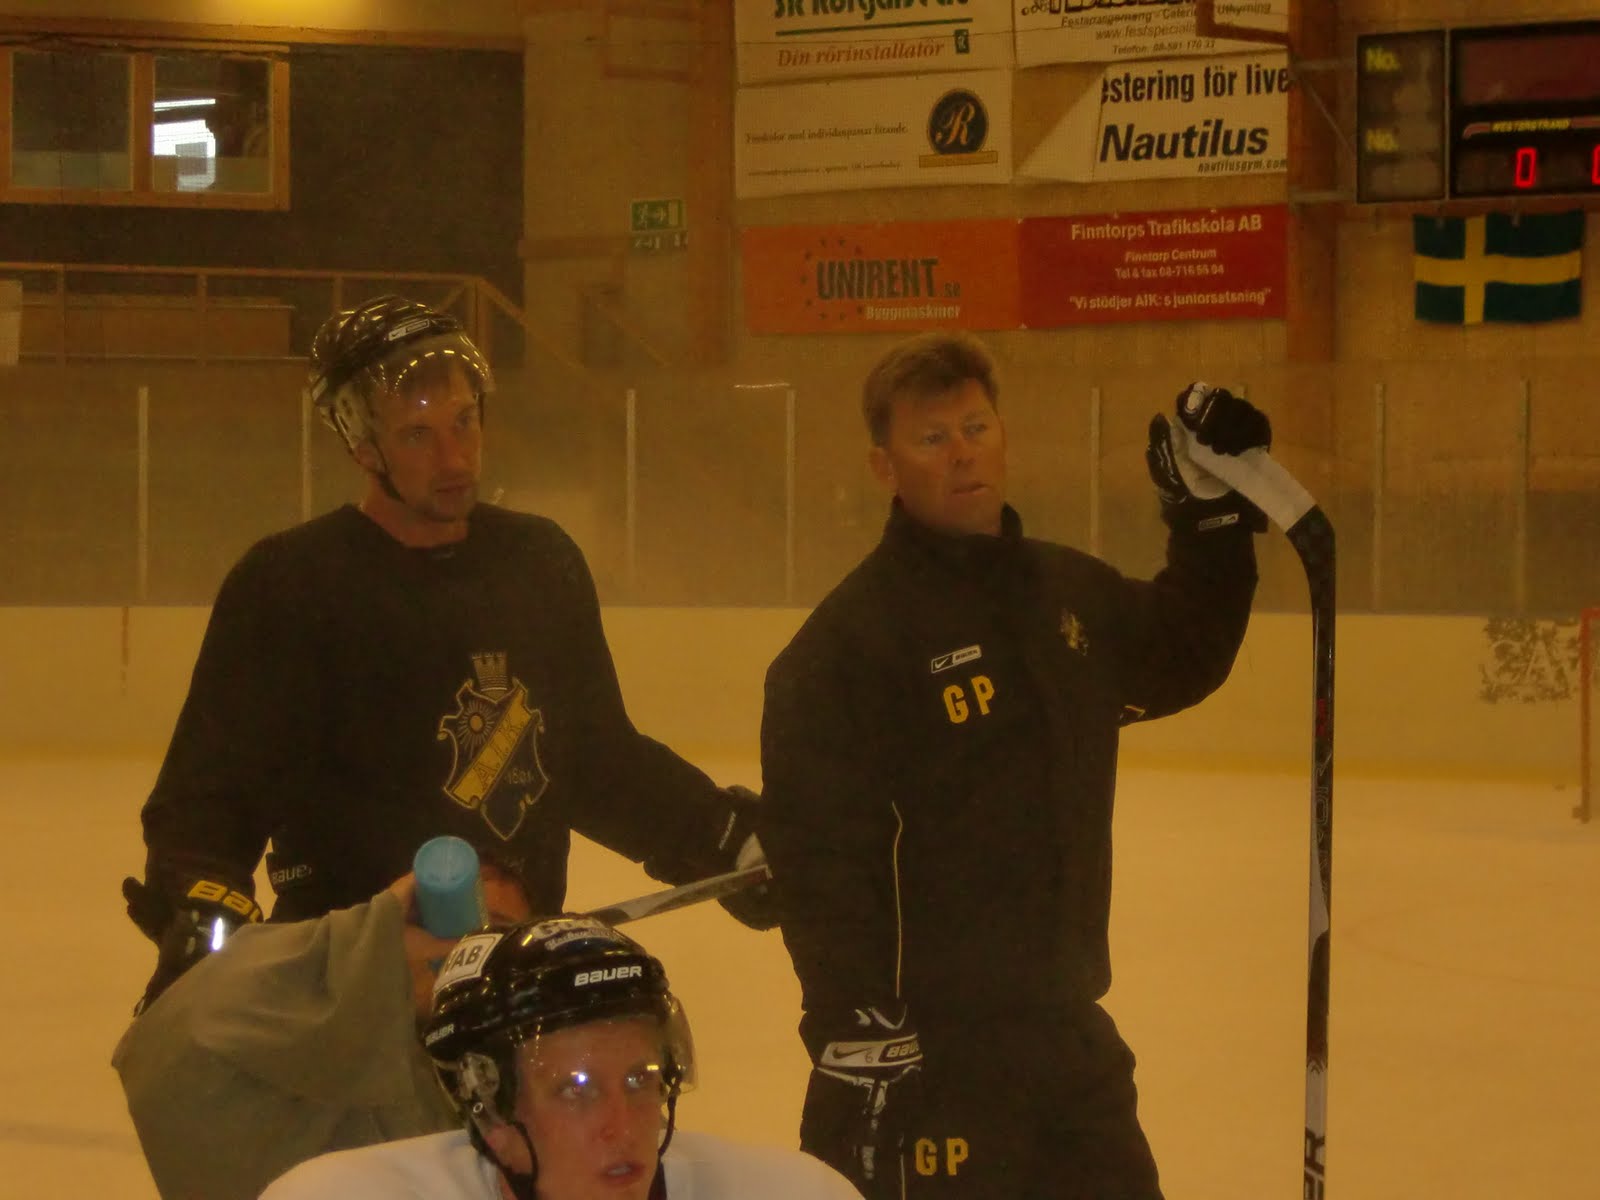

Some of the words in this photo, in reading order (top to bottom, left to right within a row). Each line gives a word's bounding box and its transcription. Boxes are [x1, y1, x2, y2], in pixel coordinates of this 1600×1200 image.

[777, 48, 810, 67] Din
[1203, 65, 1238, 97] för
[1100, 118, 1268, 163] Nautilus
[1515, 147, 1537, 188] 0
[1071, 222, 1145, 240] Finntorps
[1147, 216, 1235, 236] Trafikskola
[1238, 213, 1262, 231] AB
[816, 257, 938, 300] UNIRENT
[574, 965, 642, 987] BAUER
